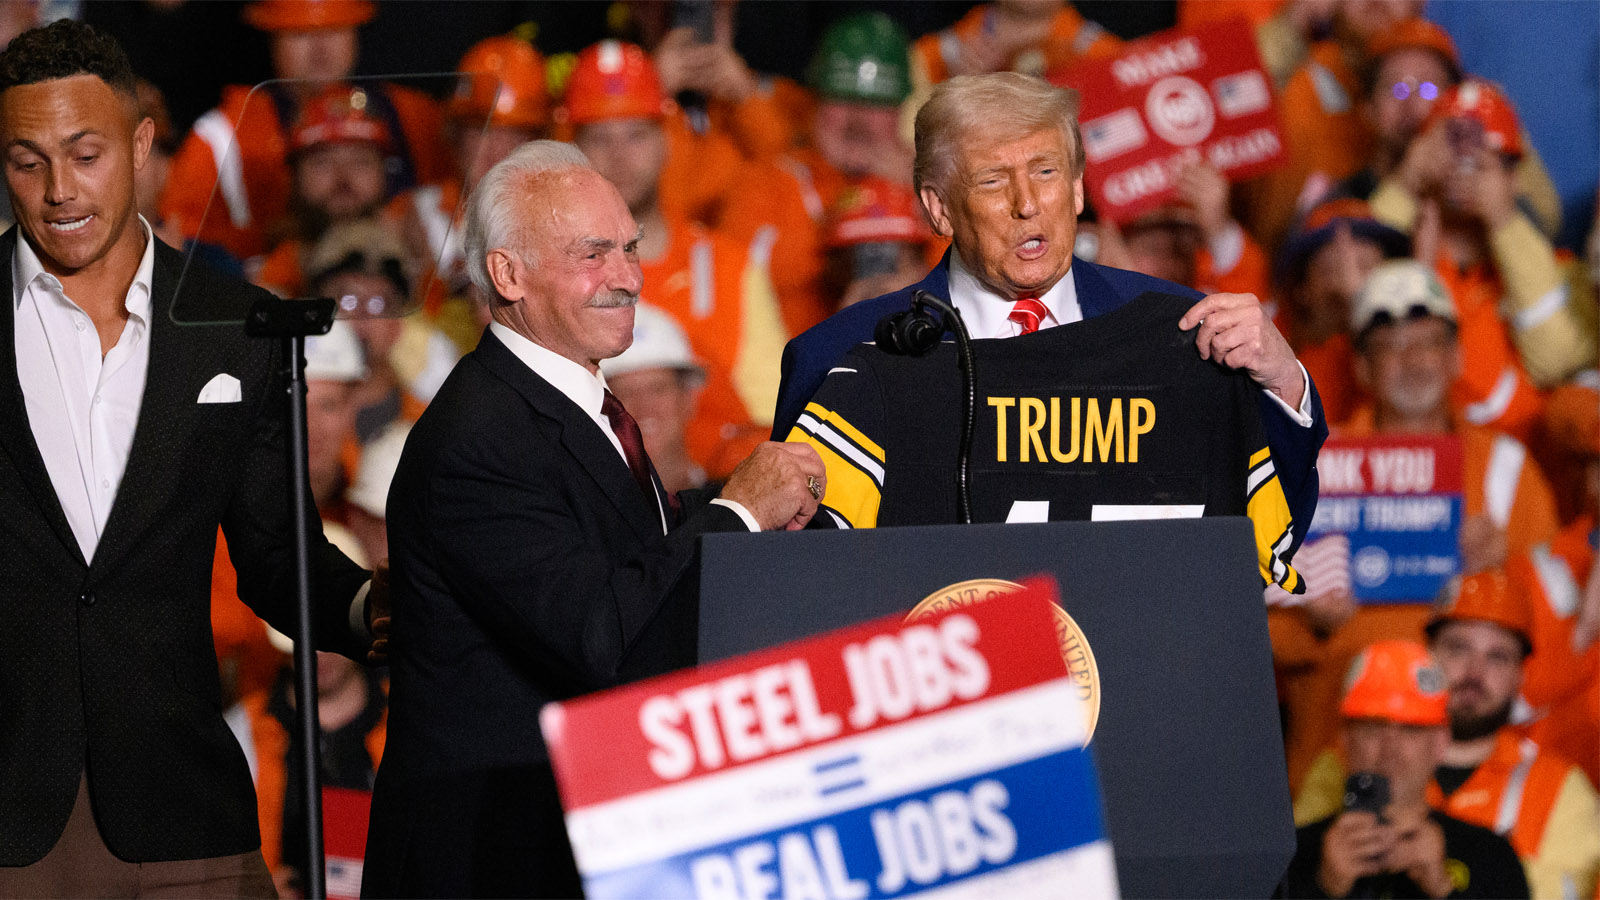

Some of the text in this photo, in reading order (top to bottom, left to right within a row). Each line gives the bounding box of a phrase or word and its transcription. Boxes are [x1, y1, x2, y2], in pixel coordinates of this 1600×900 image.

[987, 396, 1156, 463] TRUMP
[1368, 448, 1435, 494] YOU
[1364, 497, 1452, 532] TRUMP!
[639, 658, 843, 779] STEEL
[842, 613, 991, 729] JOBS
[1058, 618, 1092, 702] NITED
[690, 824, 871, 900] REAL
[871, 778, 1018, 894] JOBS
